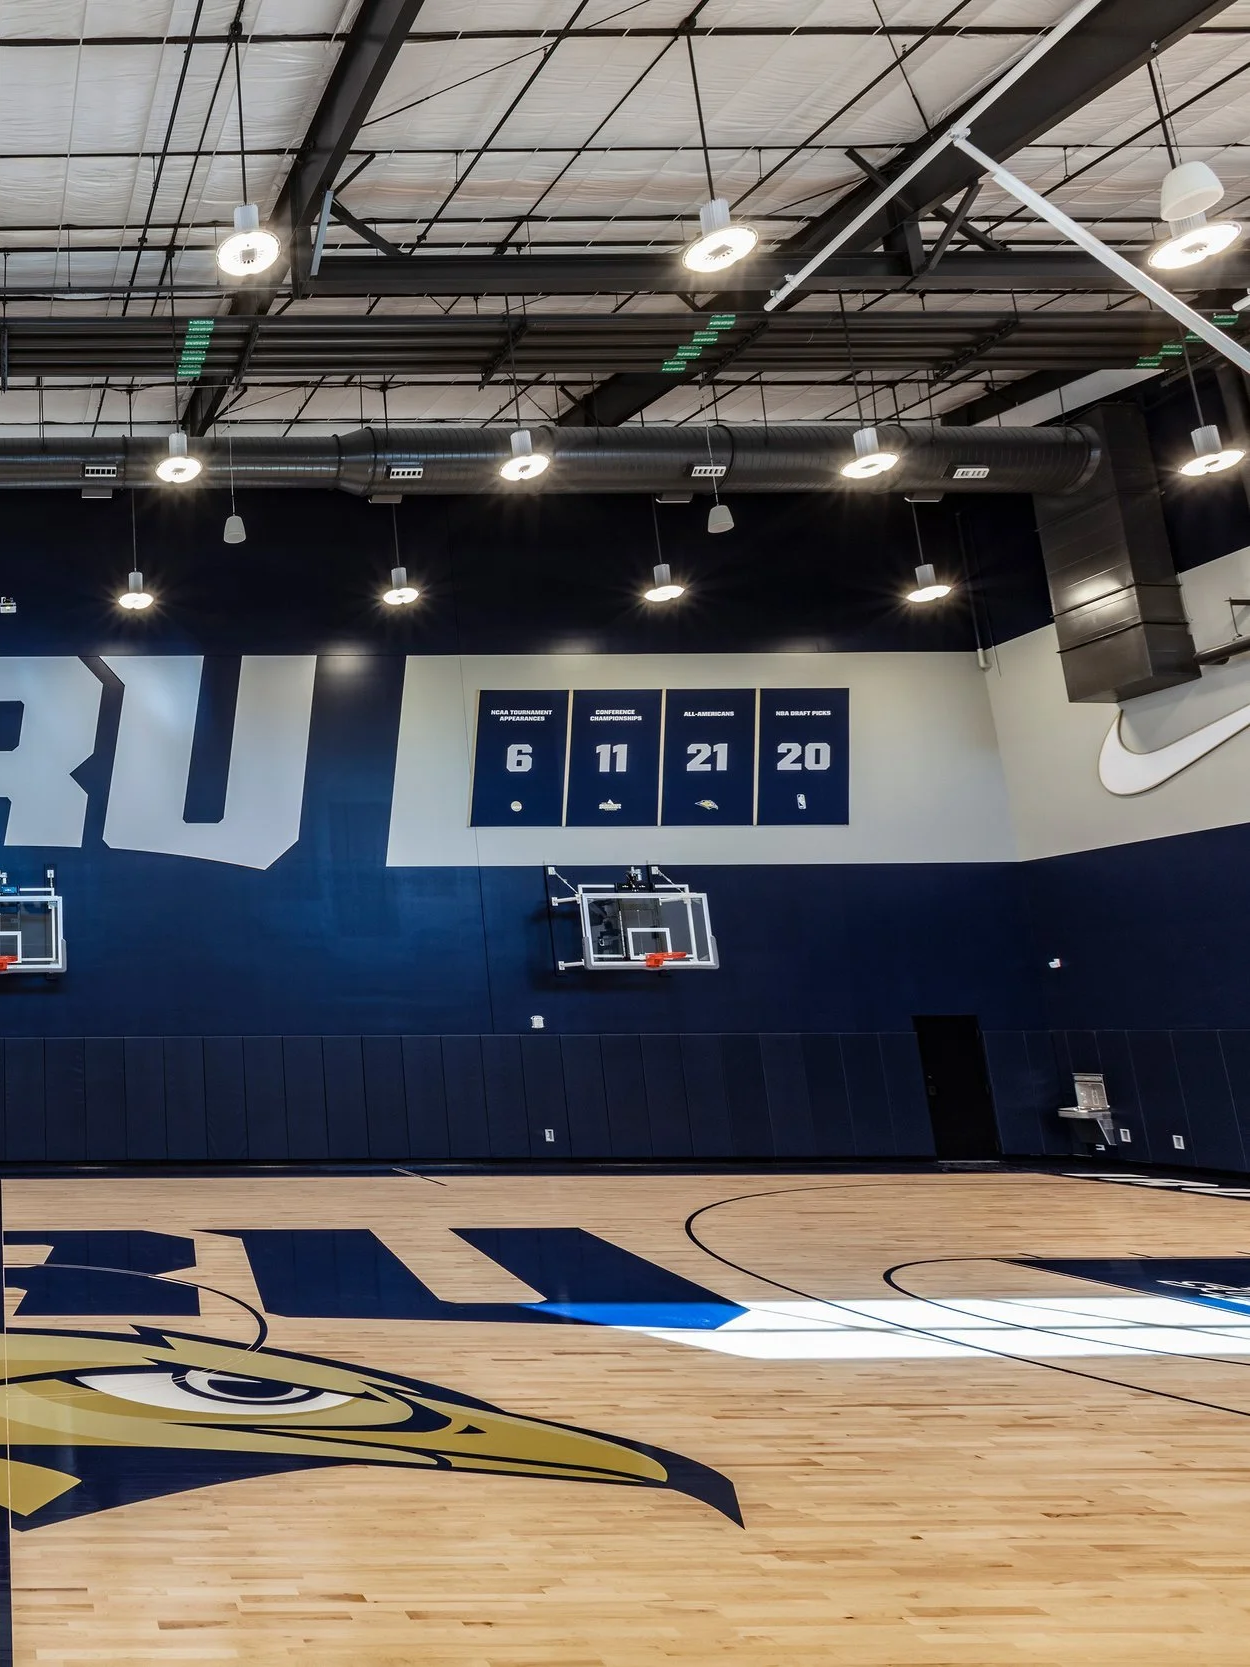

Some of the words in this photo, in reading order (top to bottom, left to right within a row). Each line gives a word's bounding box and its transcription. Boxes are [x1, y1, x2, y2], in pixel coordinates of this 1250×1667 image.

[506, 743, 533, 773] 6
[595, 743, 628, 773] 11
[686, 743, 728, 772] 21
[776, 742, 831, 771] 20
